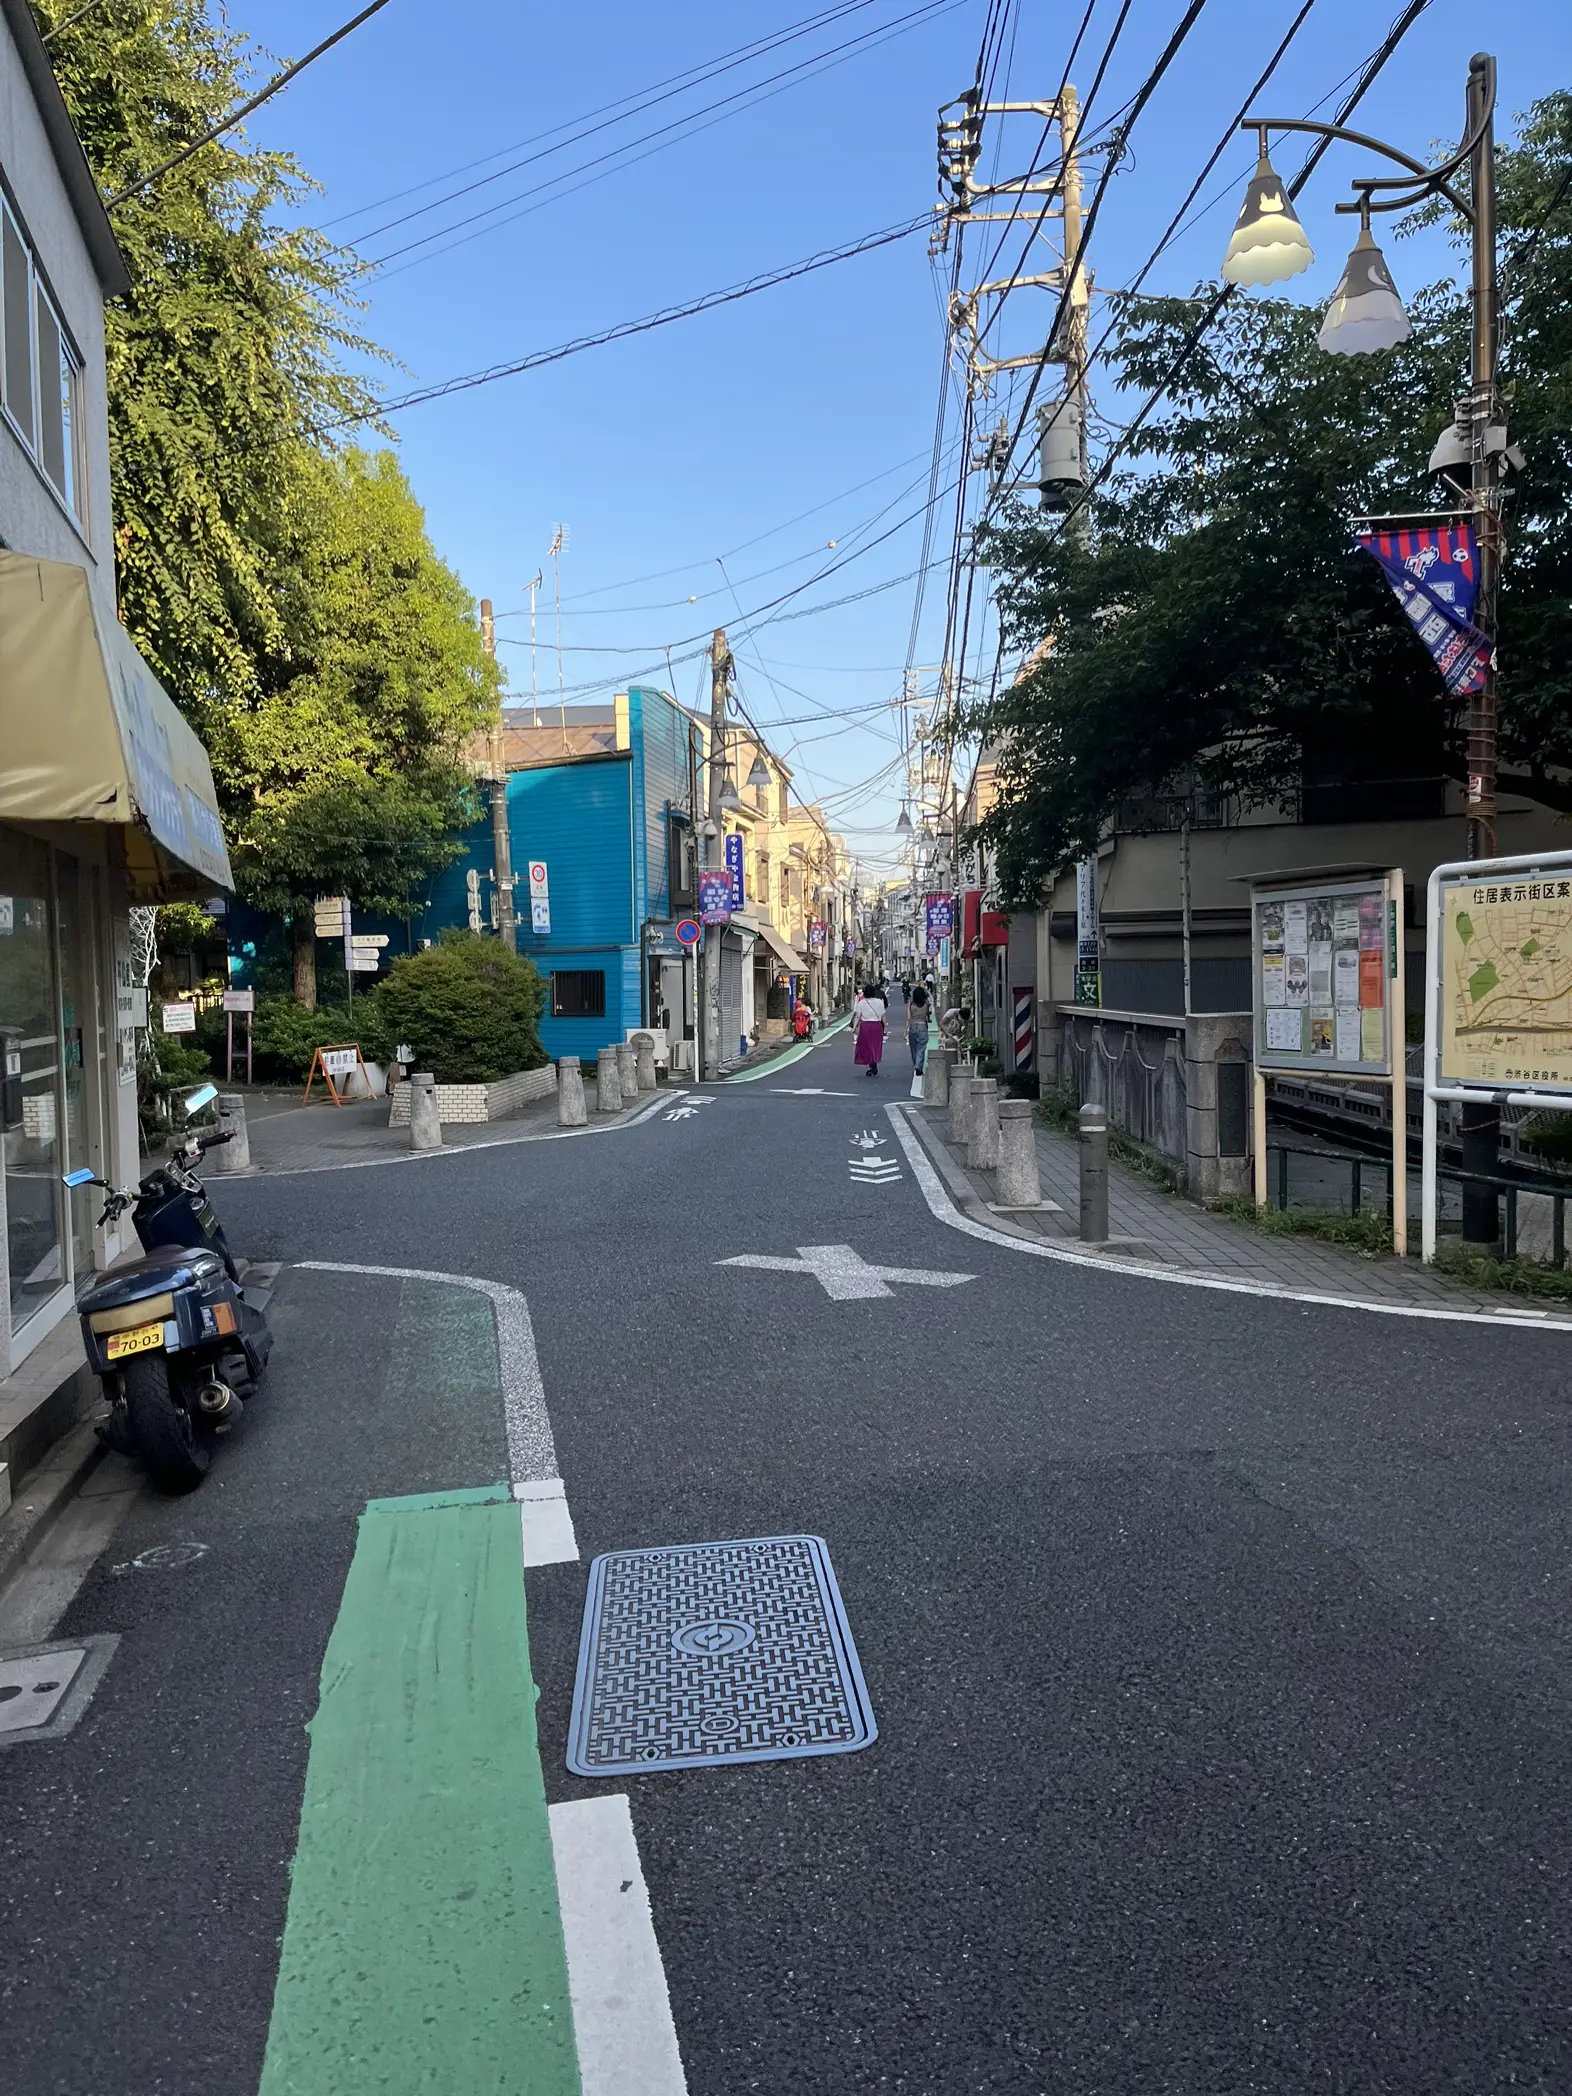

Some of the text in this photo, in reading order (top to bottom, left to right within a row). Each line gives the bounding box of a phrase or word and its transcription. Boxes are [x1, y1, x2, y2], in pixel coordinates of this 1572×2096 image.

[1473, 881, 1571, 905] 住居表示街区案
[1083, 982, 1097, 999] 文
[1513, 1069, 1559, 1081] 渋谷区役所
[120, 1333, 160, 1353] 70-03
